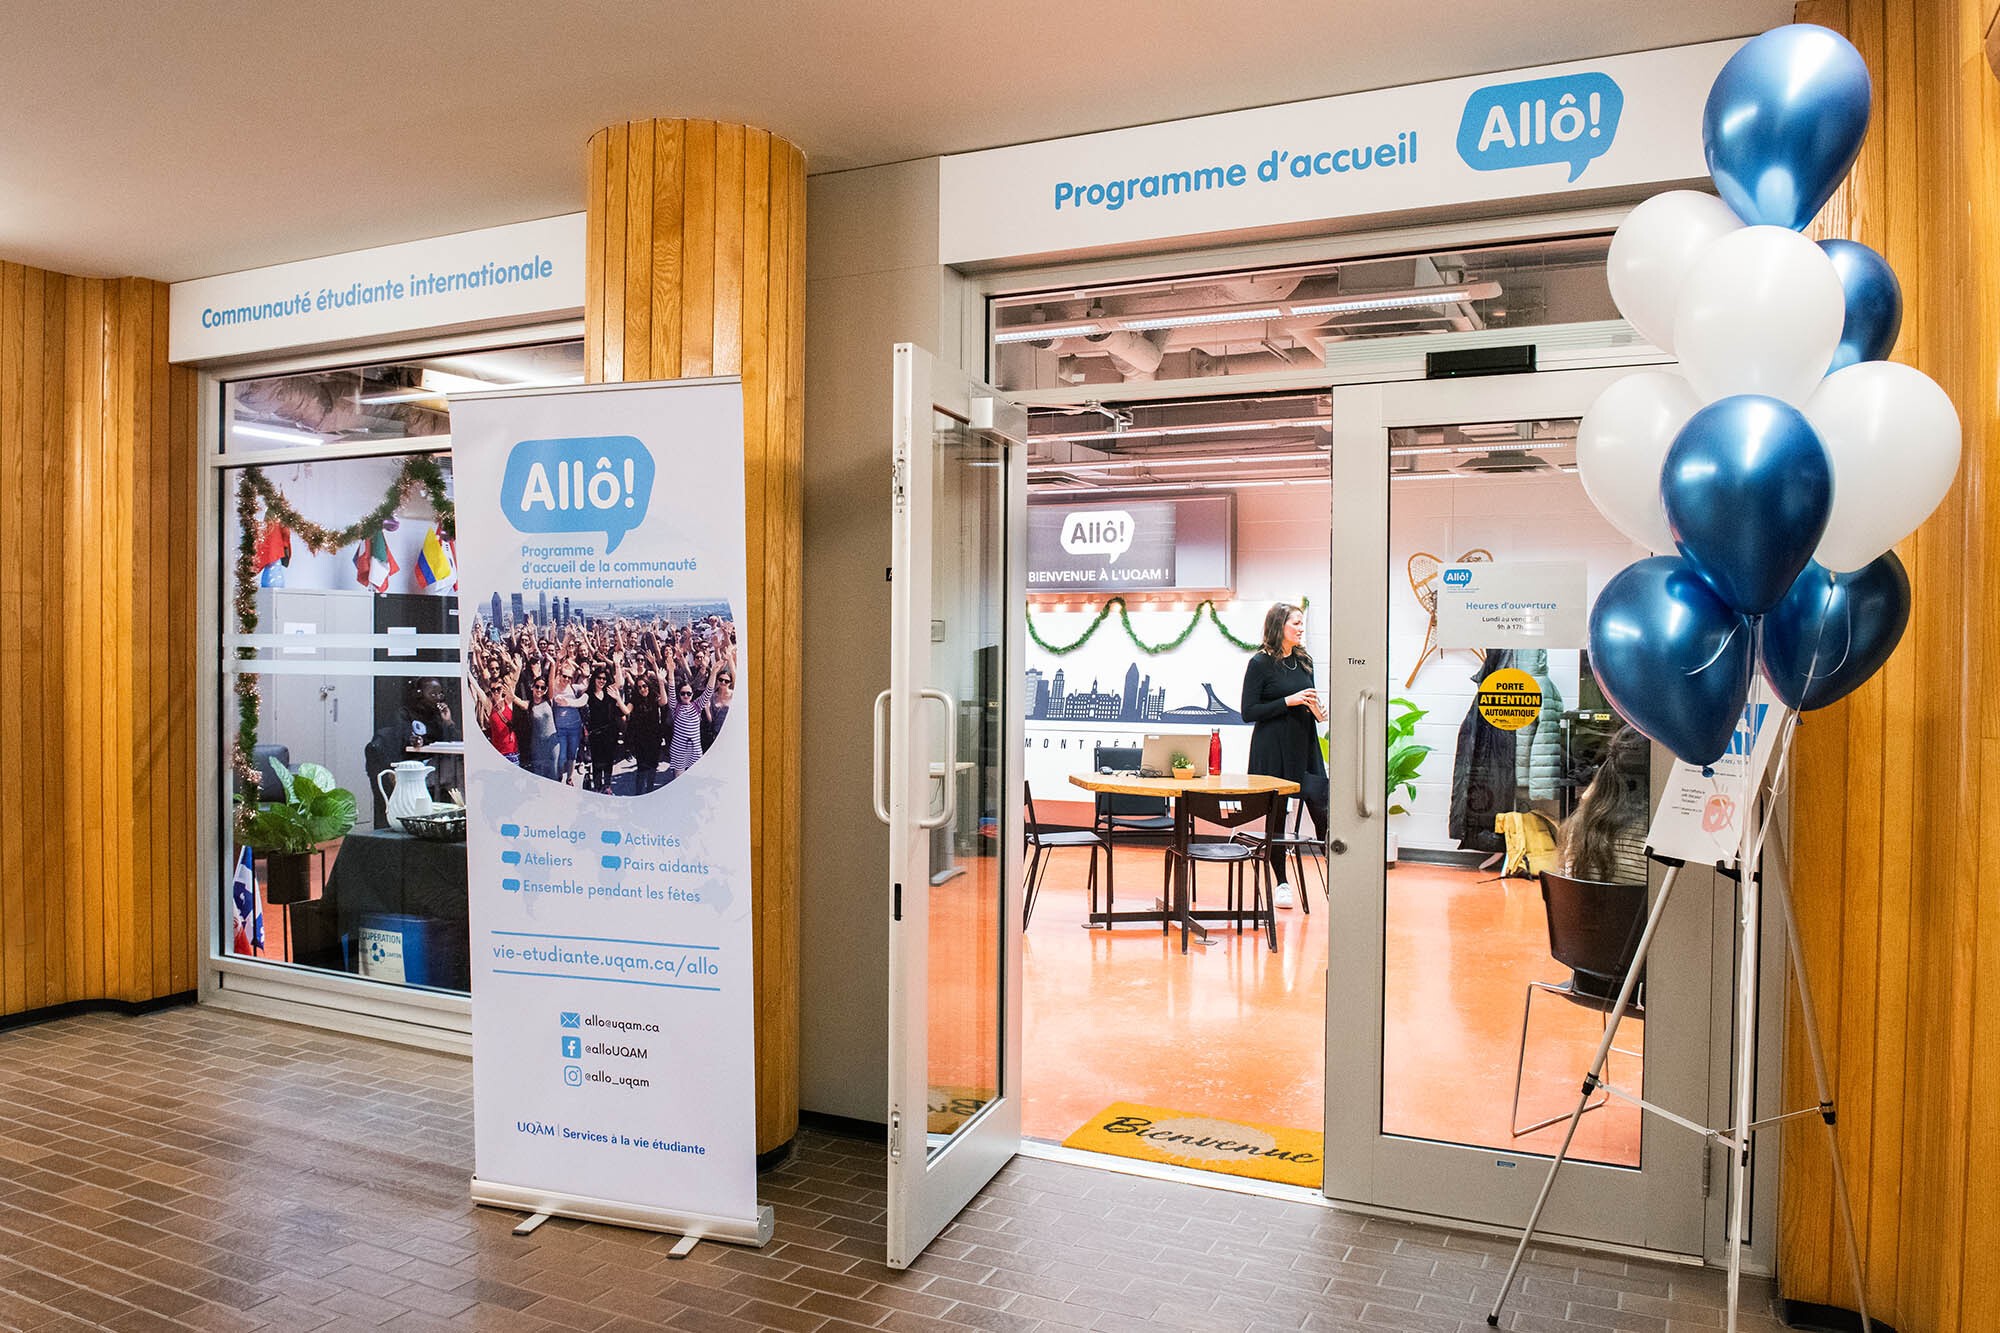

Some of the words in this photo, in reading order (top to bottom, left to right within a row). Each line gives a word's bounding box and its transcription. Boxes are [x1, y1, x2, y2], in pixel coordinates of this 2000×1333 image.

[1478, 92, 1601, 152] Allô!
[1055, 163, 1246, 210] Programme
[1258, 131, 1417, 182] d'accueil
[202, 290, 311, 329] Communauté
[317, 279, 404, 311] étudiante
[410, 255, 553, 298] internationale
[521, 456, 635, 512] Allô!
[1071, 520, 1125, 544] Allô!
[522, 546, 594, 560] Programme
[522, 560, 576, 573] d'accueil
[580, 560, 596, 573] de
[599, 560, 610, 572] la
[614, 557, 696, 572] communauté
[522, 577, 582, 590] étudiante
[586, 576, 674, 589] internationale
[1028, 570, 1096, 583] BIENVENUE
[1099, 568, 1109, 581] À
[1112, 569, 1161, 580] L'UQAM
[1447, 572, 1468, 581] Allô!
[1480, 695, 1540, 705] ATTENTION
[1485, 709, 1535, 717] AUTOMATIQUE
[1025, 738, 1136, 749] MONTRÉA
[524, 825, 586, 843] Jumelage
[625, 833, 680, 848] Activités
[525, 853, 573, 866] Ateliers
[624, 857, 655, 871] Pairs
[659, 860, 709, 874] aidants
[524, 880, 583, 895] Ensemble
[588, 883, 642, 898] pendant
[647, 885, 664, 899] les
[668, 886, 700, 902] fêtes
[493, 944, 718, 977] vie-etudiante.uqam.ca/allo
[585, 1015, 659, 1032] allo@uqam.ca
[585, 1043, 647, 1059] @alloUQAM
[585, 1071, 650, 1088] @allo_uqam
[563, 1128, 608, 1143] Services
[611, 1133, 617, 1144] à
[621, 1135, 630, 1146] la
[633, 1138, 649, 1148] vie
[652, 1138, 705, 1155] étudiante
[1103, 1116, 1319, 1164] Bienvenue
